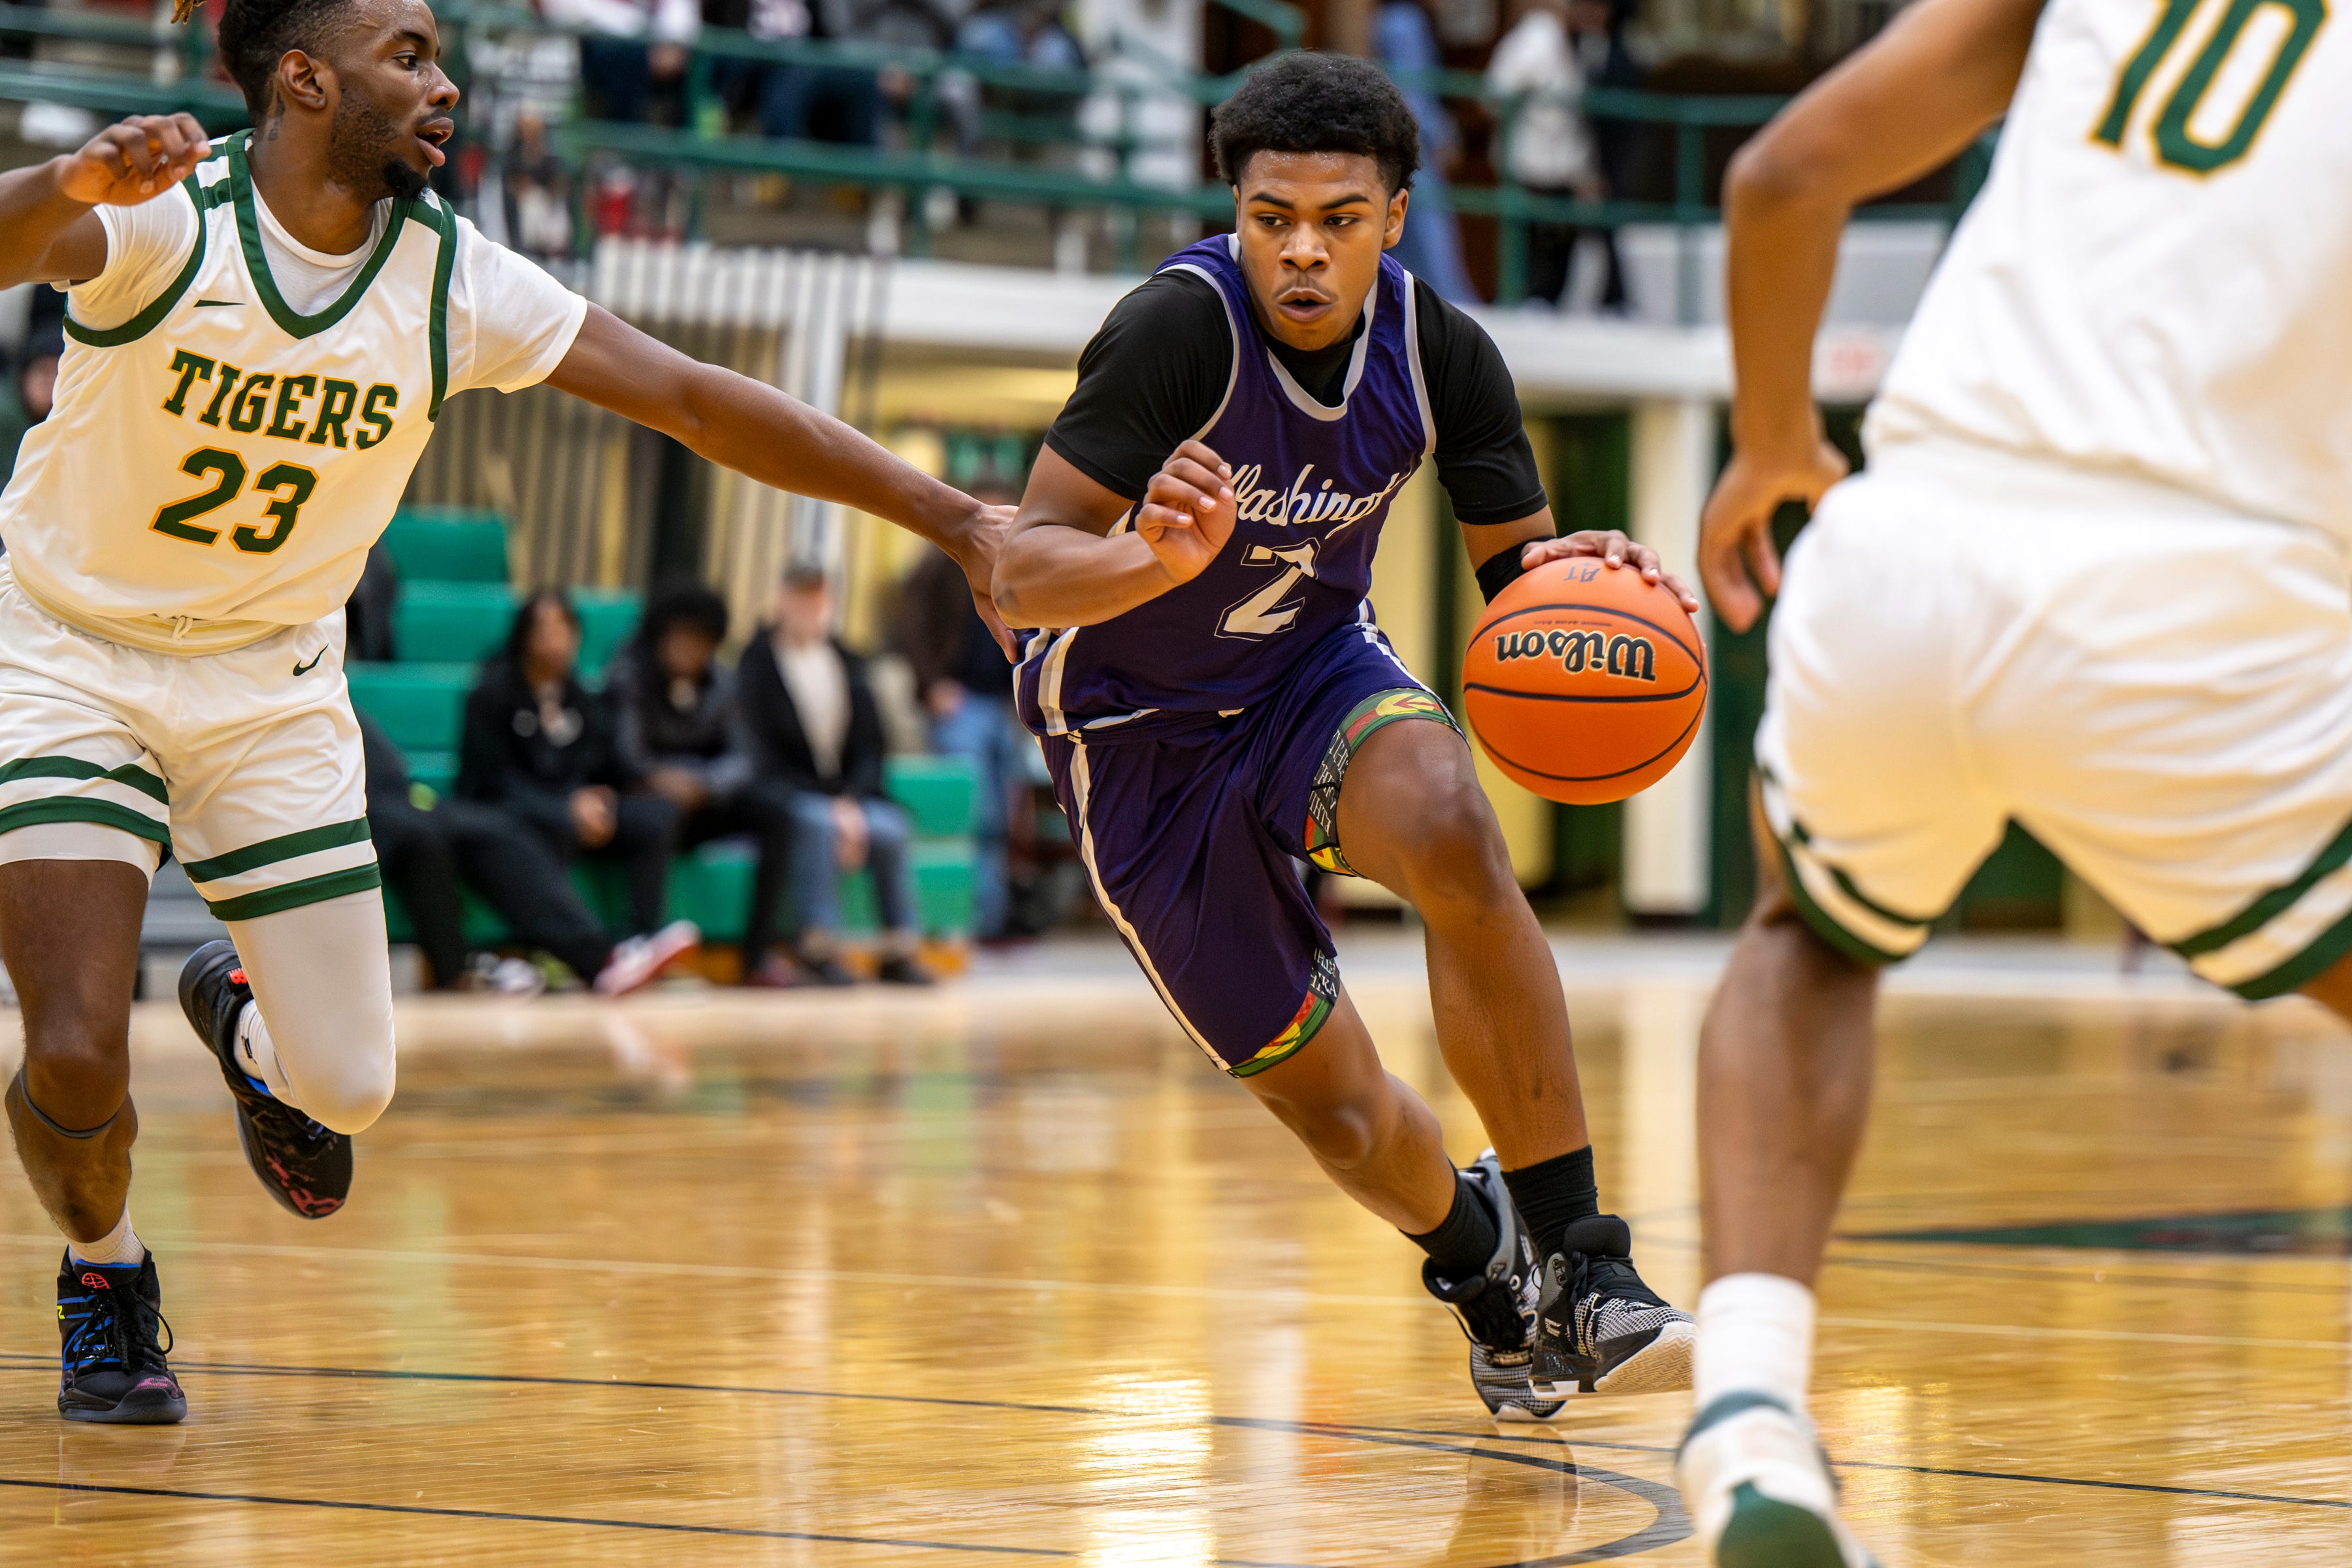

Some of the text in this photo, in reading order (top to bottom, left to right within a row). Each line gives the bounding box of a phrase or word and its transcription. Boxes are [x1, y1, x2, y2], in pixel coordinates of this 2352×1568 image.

[2085, 0, 2330, 182] 10
[161, 348, 399, 451] TIGERS
[148, 445, 320, 555] 23
[1215, 537, 1321, 642] 2
[1495, 629, 1657, 683] Wilson
